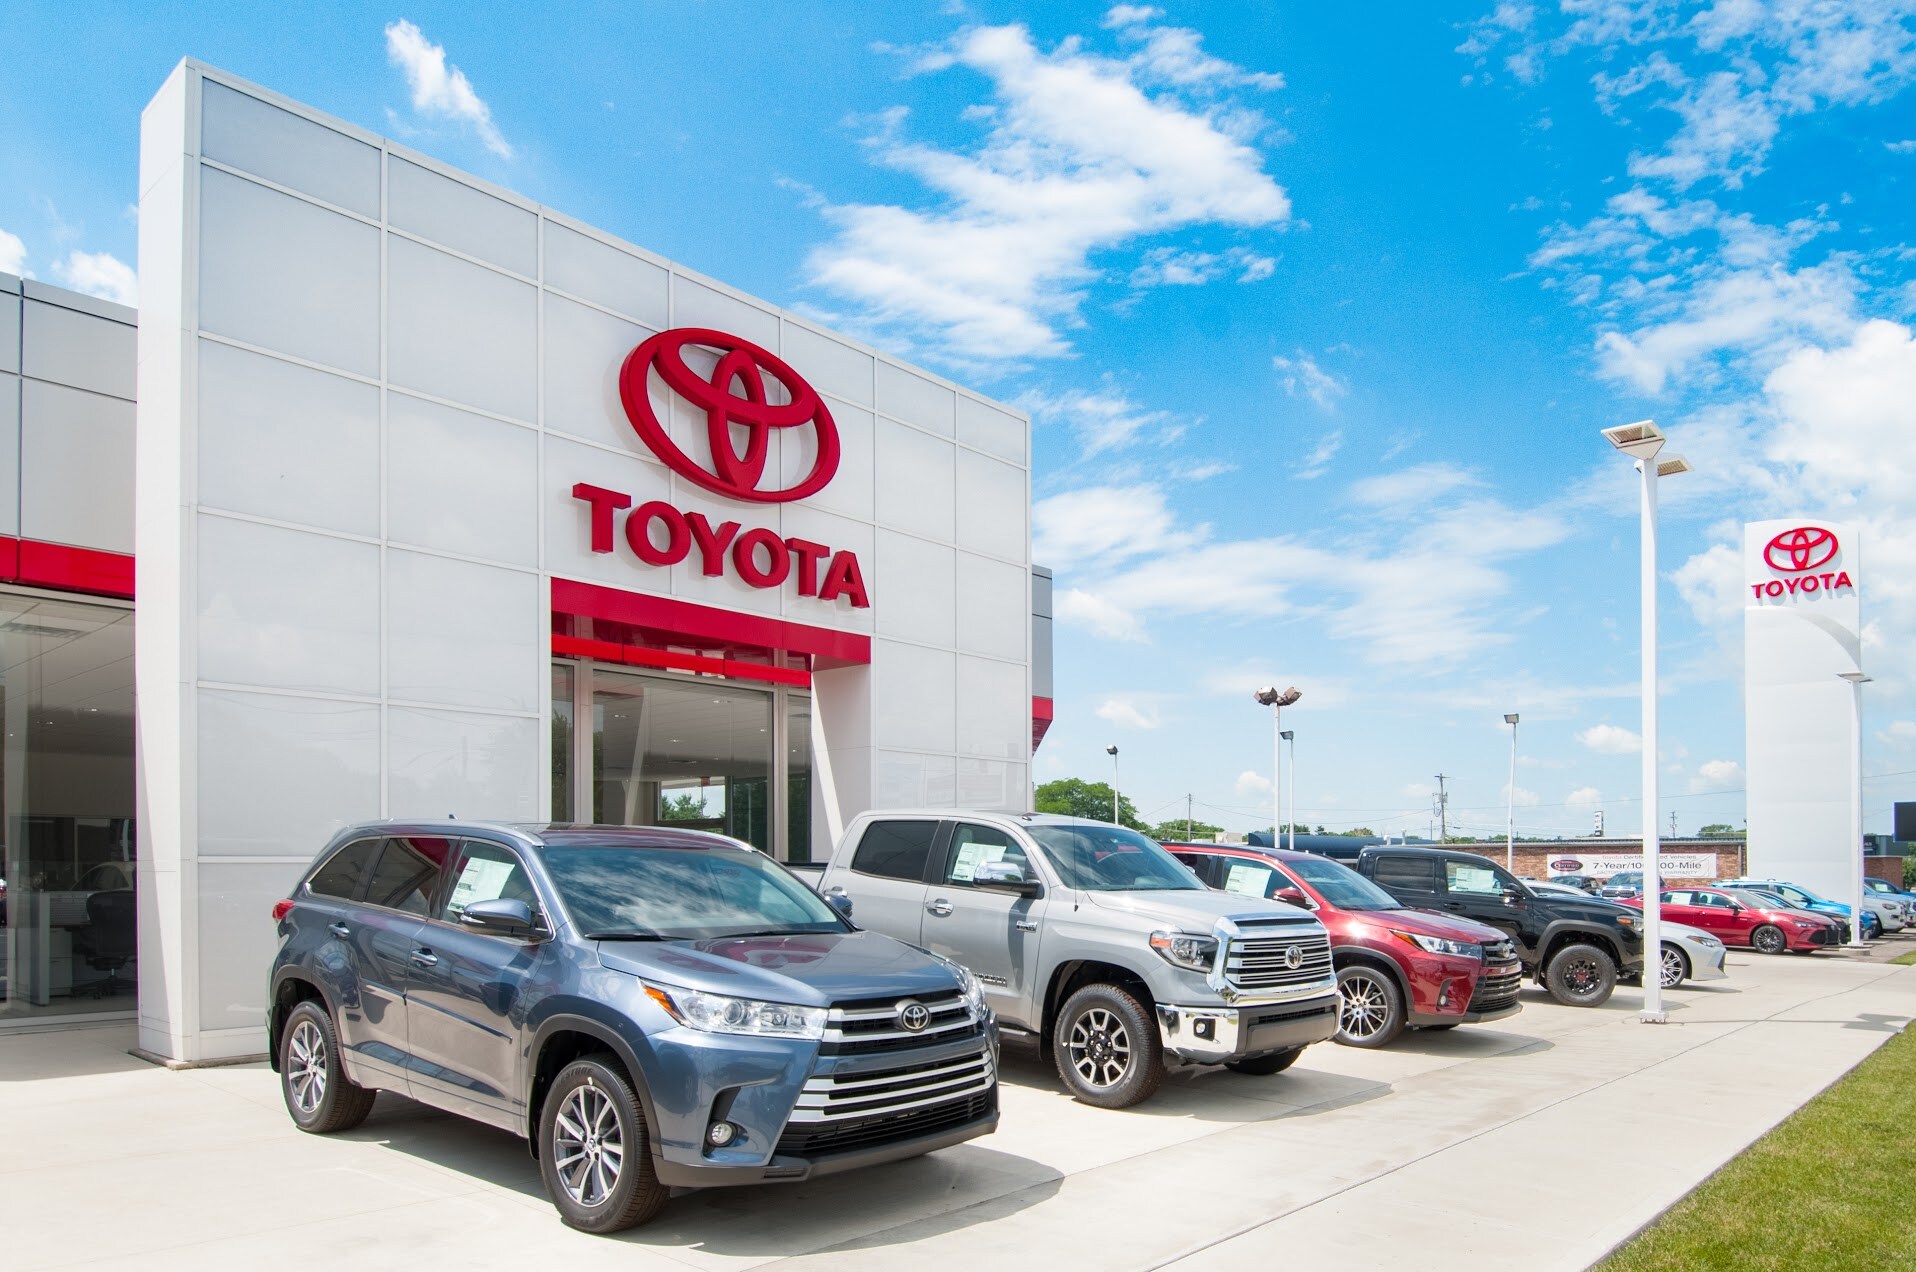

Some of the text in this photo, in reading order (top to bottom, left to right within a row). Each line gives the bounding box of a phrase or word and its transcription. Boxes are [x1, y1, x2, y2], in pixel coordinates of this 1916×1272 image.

[572, 482, 870, 609] TOYOTA
[1751, 571, 1852, 599] TOYOTA
[1593, 861, 1702, 869] 7-Year/1000-Mile
